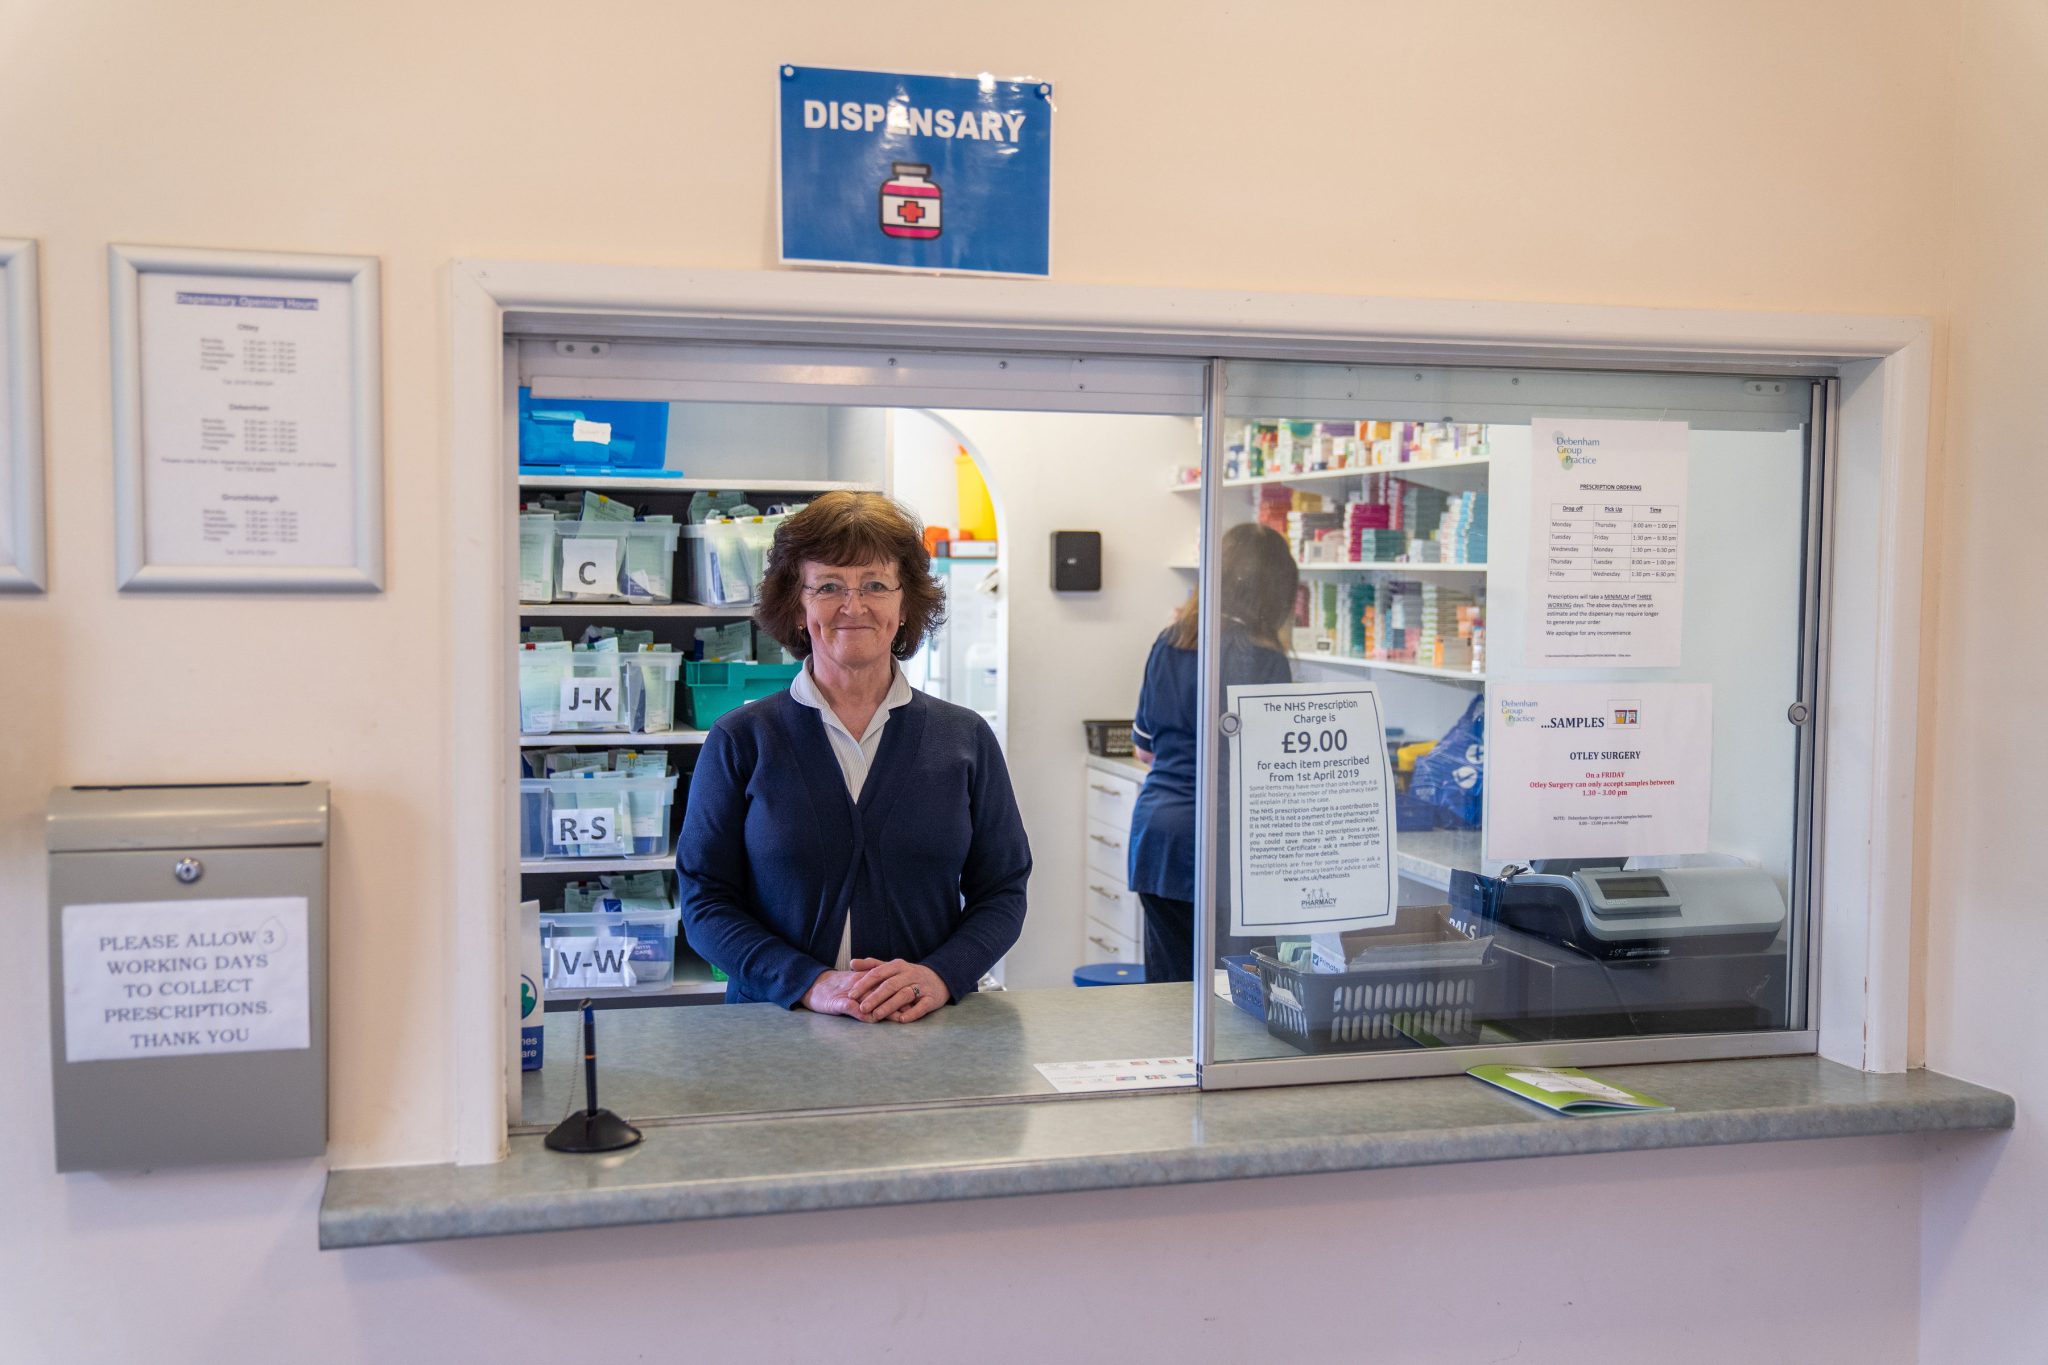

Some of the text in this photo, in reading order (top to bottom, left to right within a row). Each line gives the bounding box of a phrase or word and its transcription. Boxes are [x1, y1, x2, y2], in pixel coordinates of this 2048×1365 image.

[804, 100, 1026, 143] DISPENSARY
[1556, 437, 1600, 446] Debenham
[1557, 446, 1582, 456] Group
[1566, 456, 1597, 464] Practice
[579, 562, 597, 585] C
[569, 687, 612, 711] J-K
[1502, 700, 1538, 708] Debenham
[1264, 700, 1358, 712] The NHS Prescription
[1294, 714, 1336, 724] Charge is
[1541, 718, 1605, 729] ...SAMPLES
[1282, 729, 1348, 754] £9.00
[1570, 751, 1641, 760] OTLEY SURGERY
[1257, 761, 1270, 770] for
[1300, 760, 1321, 768] item
[1324, 756, 1369, 769] prescribed
[1270, 769, 1359, 782] from 1st April 2019
[1530, 781, 1547, 789] Otley
[1549, 781, 1574, 789] Surgery
[1603, 780, 1623, 788] accept
[1625, 780, 1649, 788] samples
[560, 816, 607, 841] R-S
[1326, 827, 1360, 836] prescriptions
[1348, 833, 1380, 841] Prescription
[1250, 846, 1284, 854] Prepayment
[1301, 898, 1337, 907] PHARMACY
[100, 930, 275, 951] PLEASE ALLOW 3
[107, 954, 268, 975] WORKING DAYS
[560, 950, 625, 975] V-W
[124, 978, 254, 998] TO COLLECT
[105, 1001, 272, 1023] PRESCRIPTIONS.
[130, 1028, 249, 1049] THANK YOU
